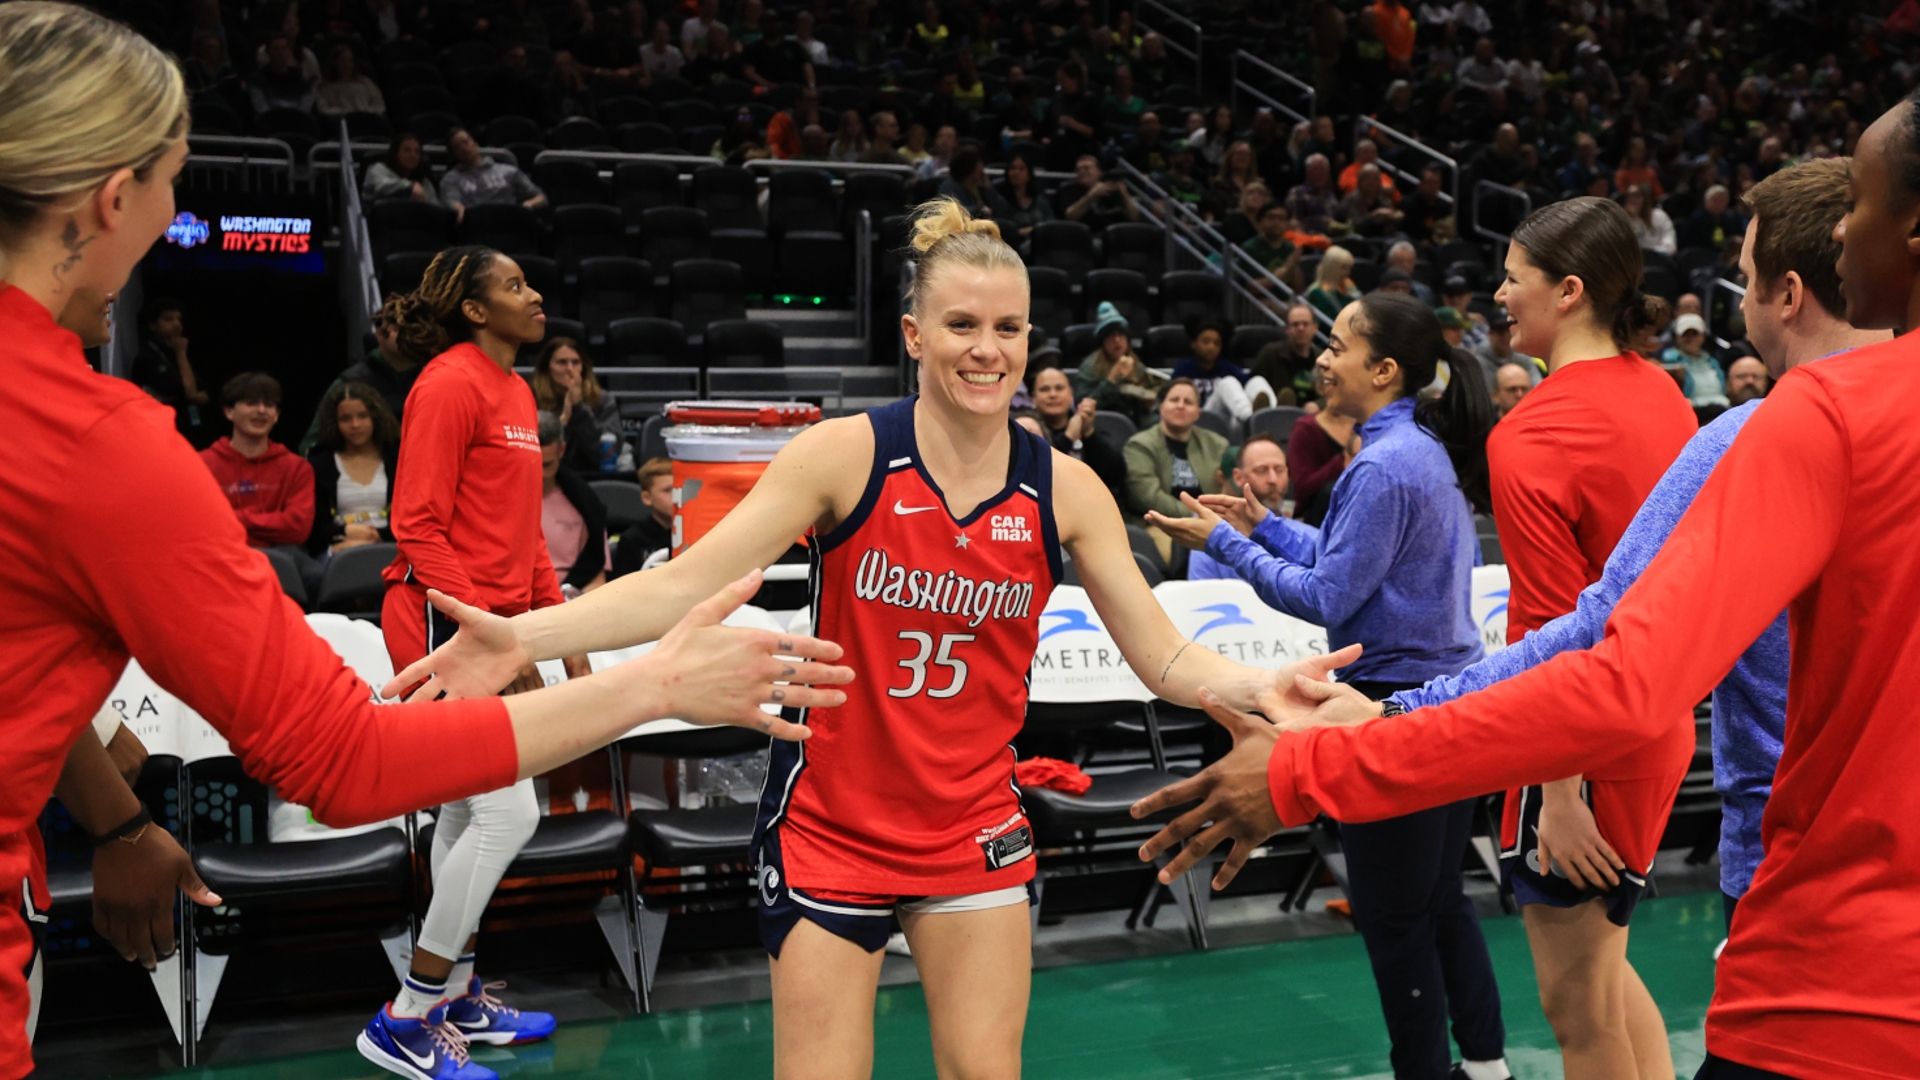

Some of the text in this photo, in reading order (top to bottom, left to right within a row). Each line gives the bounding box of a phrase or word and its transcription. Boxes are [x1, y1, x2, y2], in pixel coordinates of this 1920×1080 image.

[220, 216, 311, 234] WASHINGTON
[222, 232, 311, 253] MYSTICS
[990, 514, 1026, 529] CAR
[991, 528, 1032, 542] max
[887, 630, 976, 698] 35
